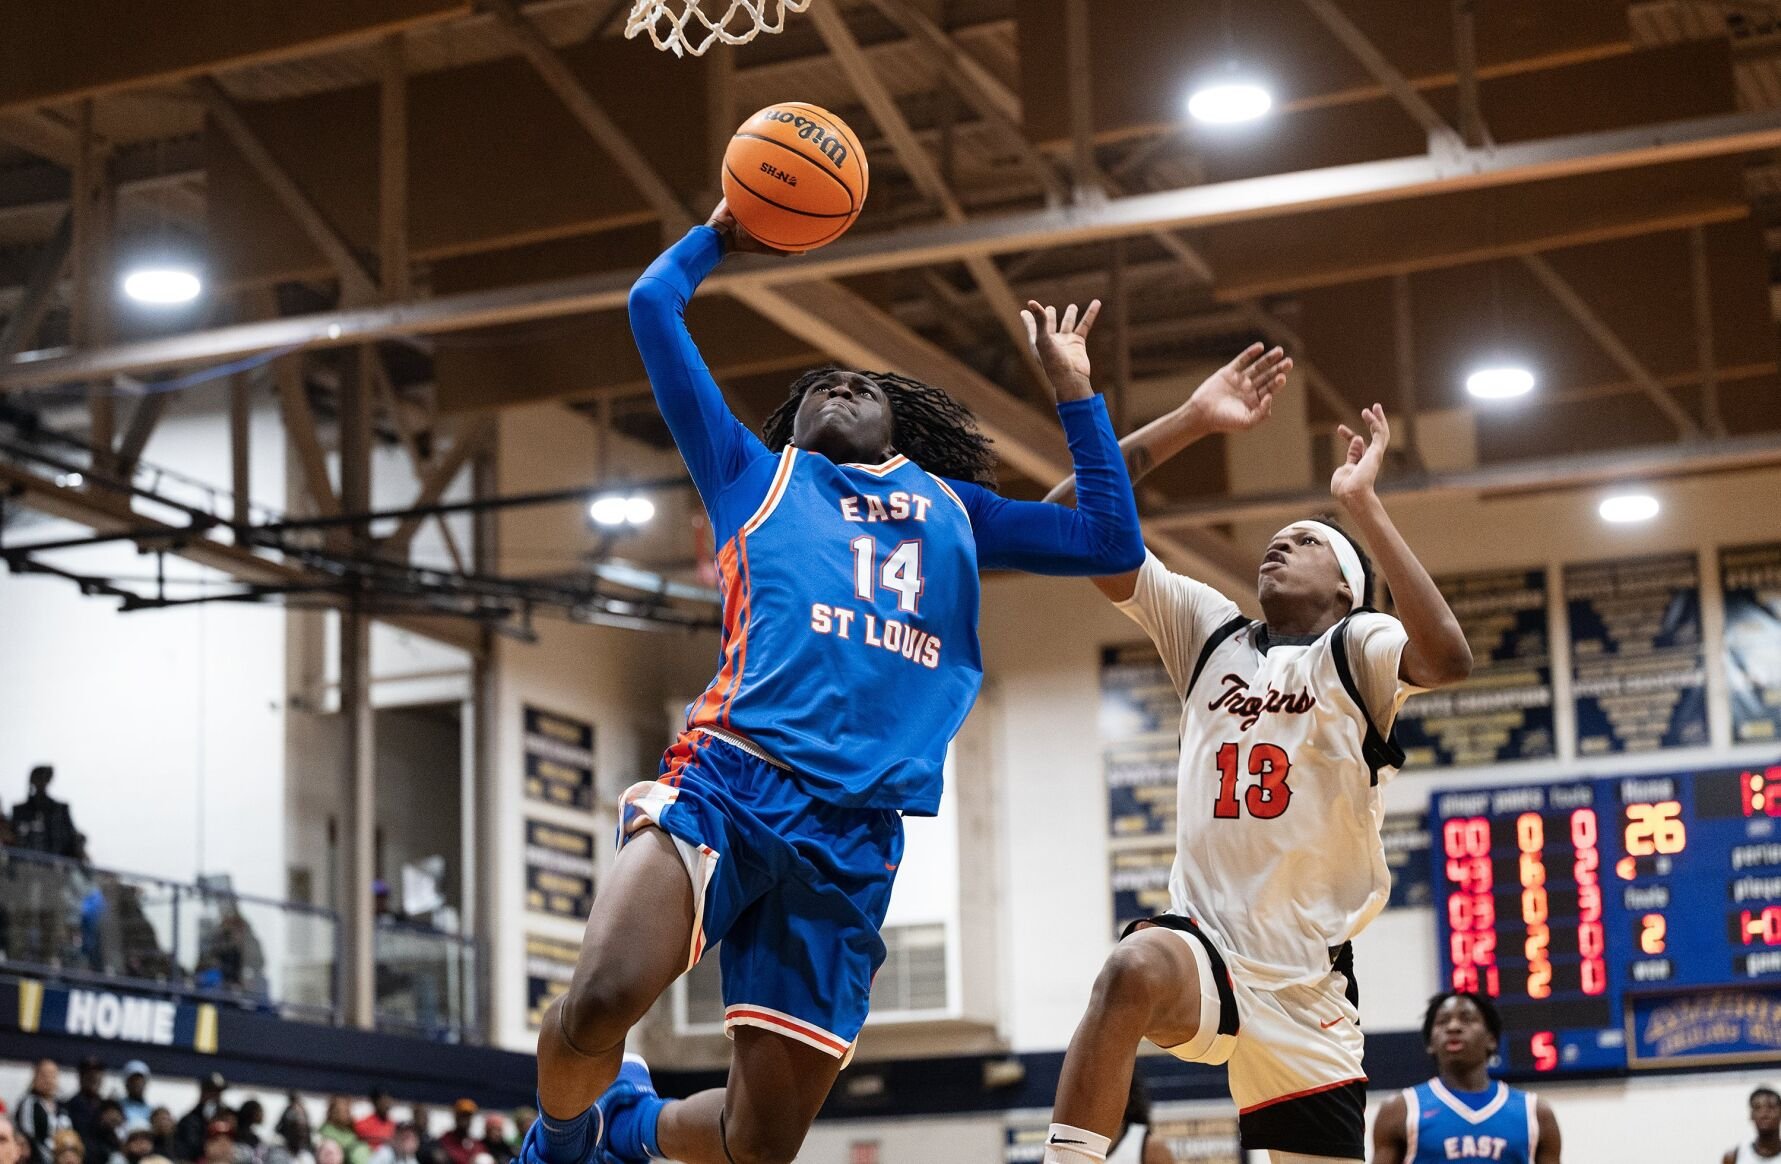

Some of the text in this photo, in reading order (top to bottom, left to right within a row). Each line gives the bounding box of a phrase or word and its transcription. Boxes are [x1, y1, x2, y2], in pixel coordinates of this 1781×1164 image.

[765, 111, 847, 169] Wilson
[760, 162, 790, 184] NFHS
[839, 491, 933, 522] EAST
[850, 534, 925, 615] 14
[811, 602, 942, 670] ST LOUIS
[1213, 742, 1293, 820] 13
[1517, 812, 1543, 852] 0
[1571, 808, 1597, 849] 0
[1625, 801, 1686, 856] 26
[1641, 913, 1666, 954] 2
[1527, 959, 1552, 999] 2
[1580, 957, 1606, 995] 0
[65, 989, 177, 1046] HOME
[1531, 1031, 1558, 1071] 5
[1443, 1135, 1507, 1161] EAST
